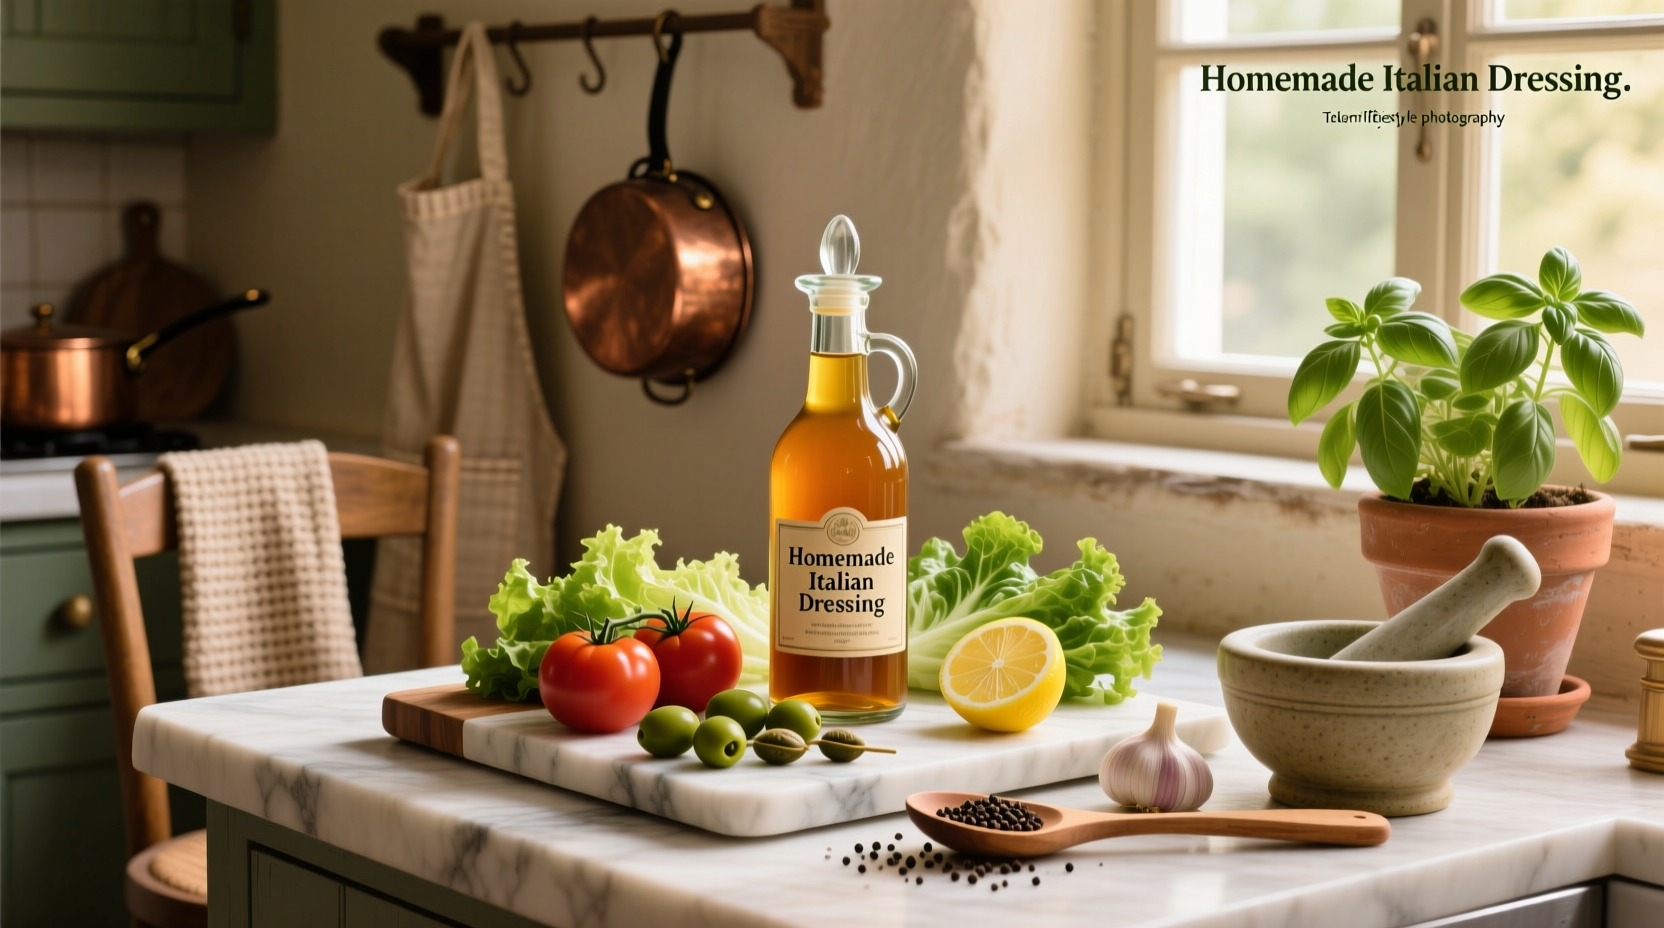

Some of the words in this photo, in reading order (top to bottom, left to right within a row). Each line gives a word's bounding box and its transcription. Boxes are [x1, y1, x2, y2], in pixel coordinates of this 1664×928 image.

[788, 546, 895, 567] Homemade
[808, 571, 874, 591] Italian
[799, 592, 886, 618] Dressing
